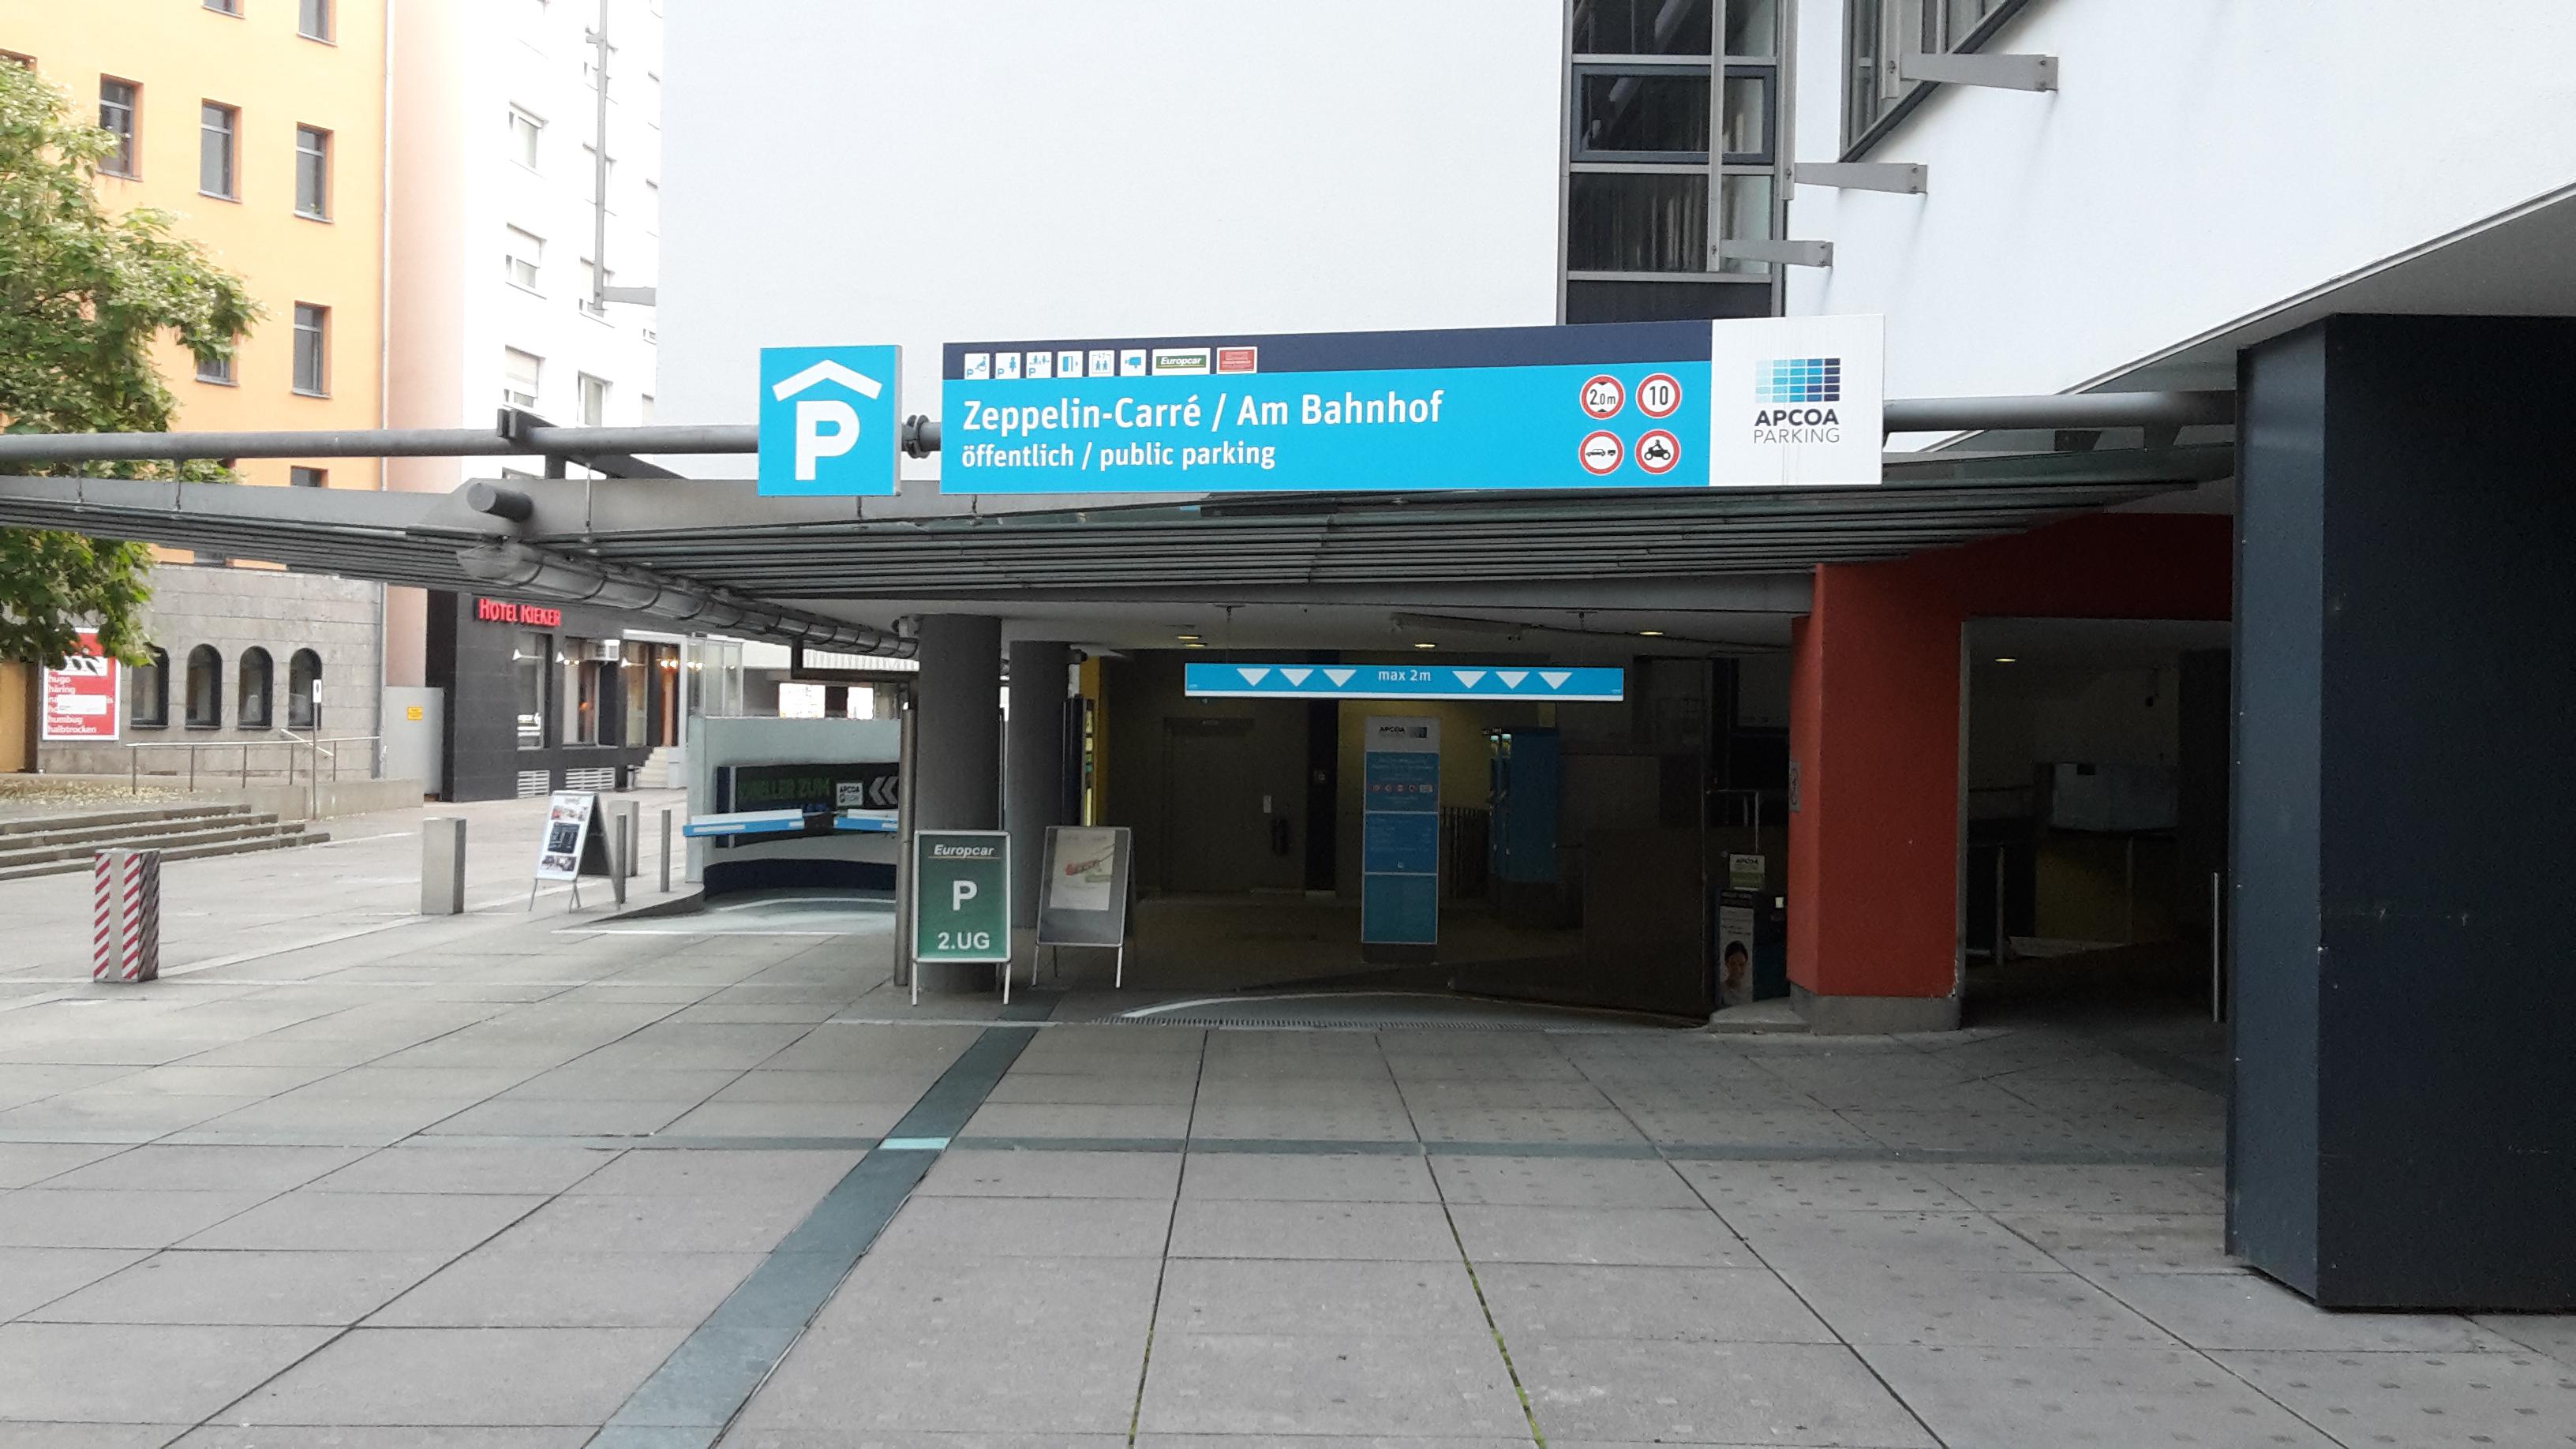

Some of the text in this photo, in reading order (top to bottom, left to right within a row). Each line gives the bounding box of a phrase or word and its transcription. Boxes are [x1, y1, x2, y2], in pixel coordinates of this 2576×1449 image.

[1160, 356, 1201, 366] Europcar
[1649, 385, 1668, 406] 10
[962, 390, 1444, 437] Zeppelin-Carré / Am Bahnhof
[1754, 409, 1840, 427] APCOA
[795, 400, 860, 481] P
[1754, 427, 1840, 444] PARKING
[961, 440, 1275, 471] öffentlich / public parking
[478, 597, 519, 622] HOTEL
[48, 676, 71, 684] hugo
[1378, 669, 1431, 682] max 2m
[47, 714, 83, 724] humbug
[934, 844, 994, 859] Europcar
[953, 879, 978, 912] P
[938, 931, 990, 949] 2.UG
